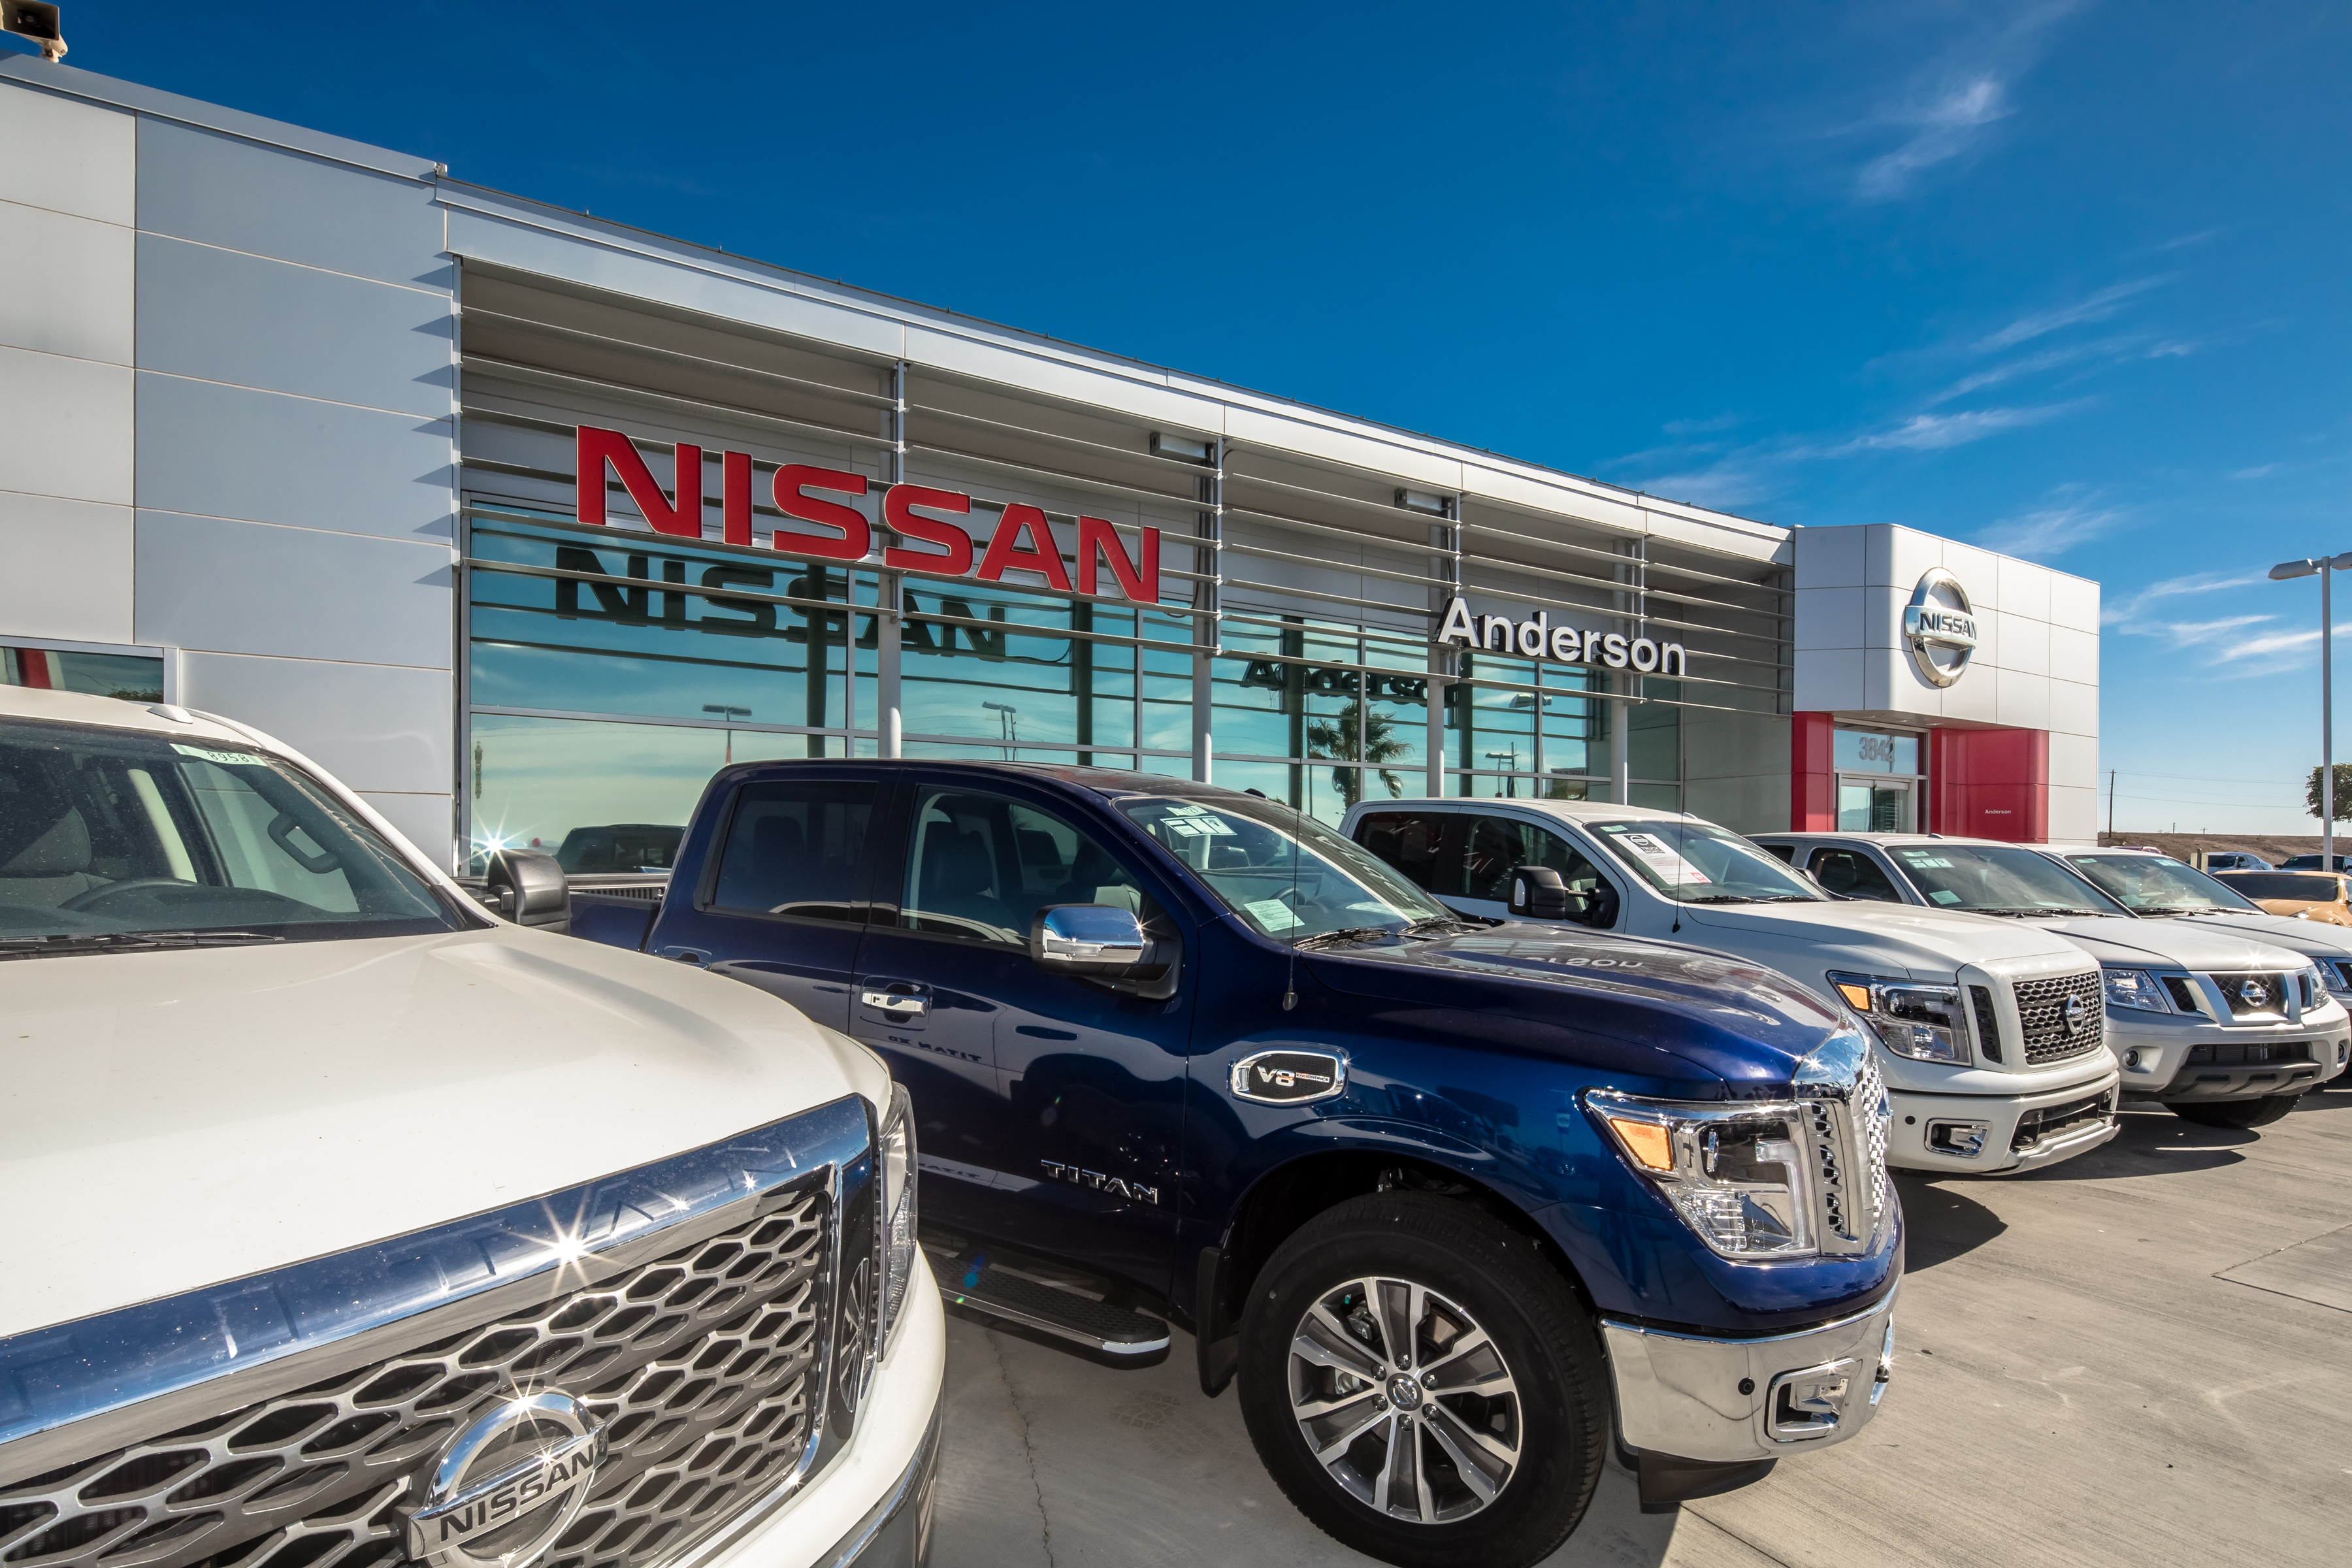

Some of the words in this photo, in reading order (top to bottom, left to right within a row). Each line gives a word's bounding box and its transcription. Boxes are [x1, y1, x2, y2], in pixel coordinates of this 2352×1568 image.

[576, 424, 1160, 604] NISSAN
[1435, 596, 1686, 676] Anderson
[1919, 612, 1977, 640] NISSAN
[206, 751, 250, 762] 8958
[1859, 736, 1896, 762] 3842
[1256, 1065, 1296, 1087] V8
[1296, 1073, 1330, 1082] ENDURANCE
[1041, 1159, 1158, 1205] TITAN
[438, 1443, 595, 1543] NISSAN
